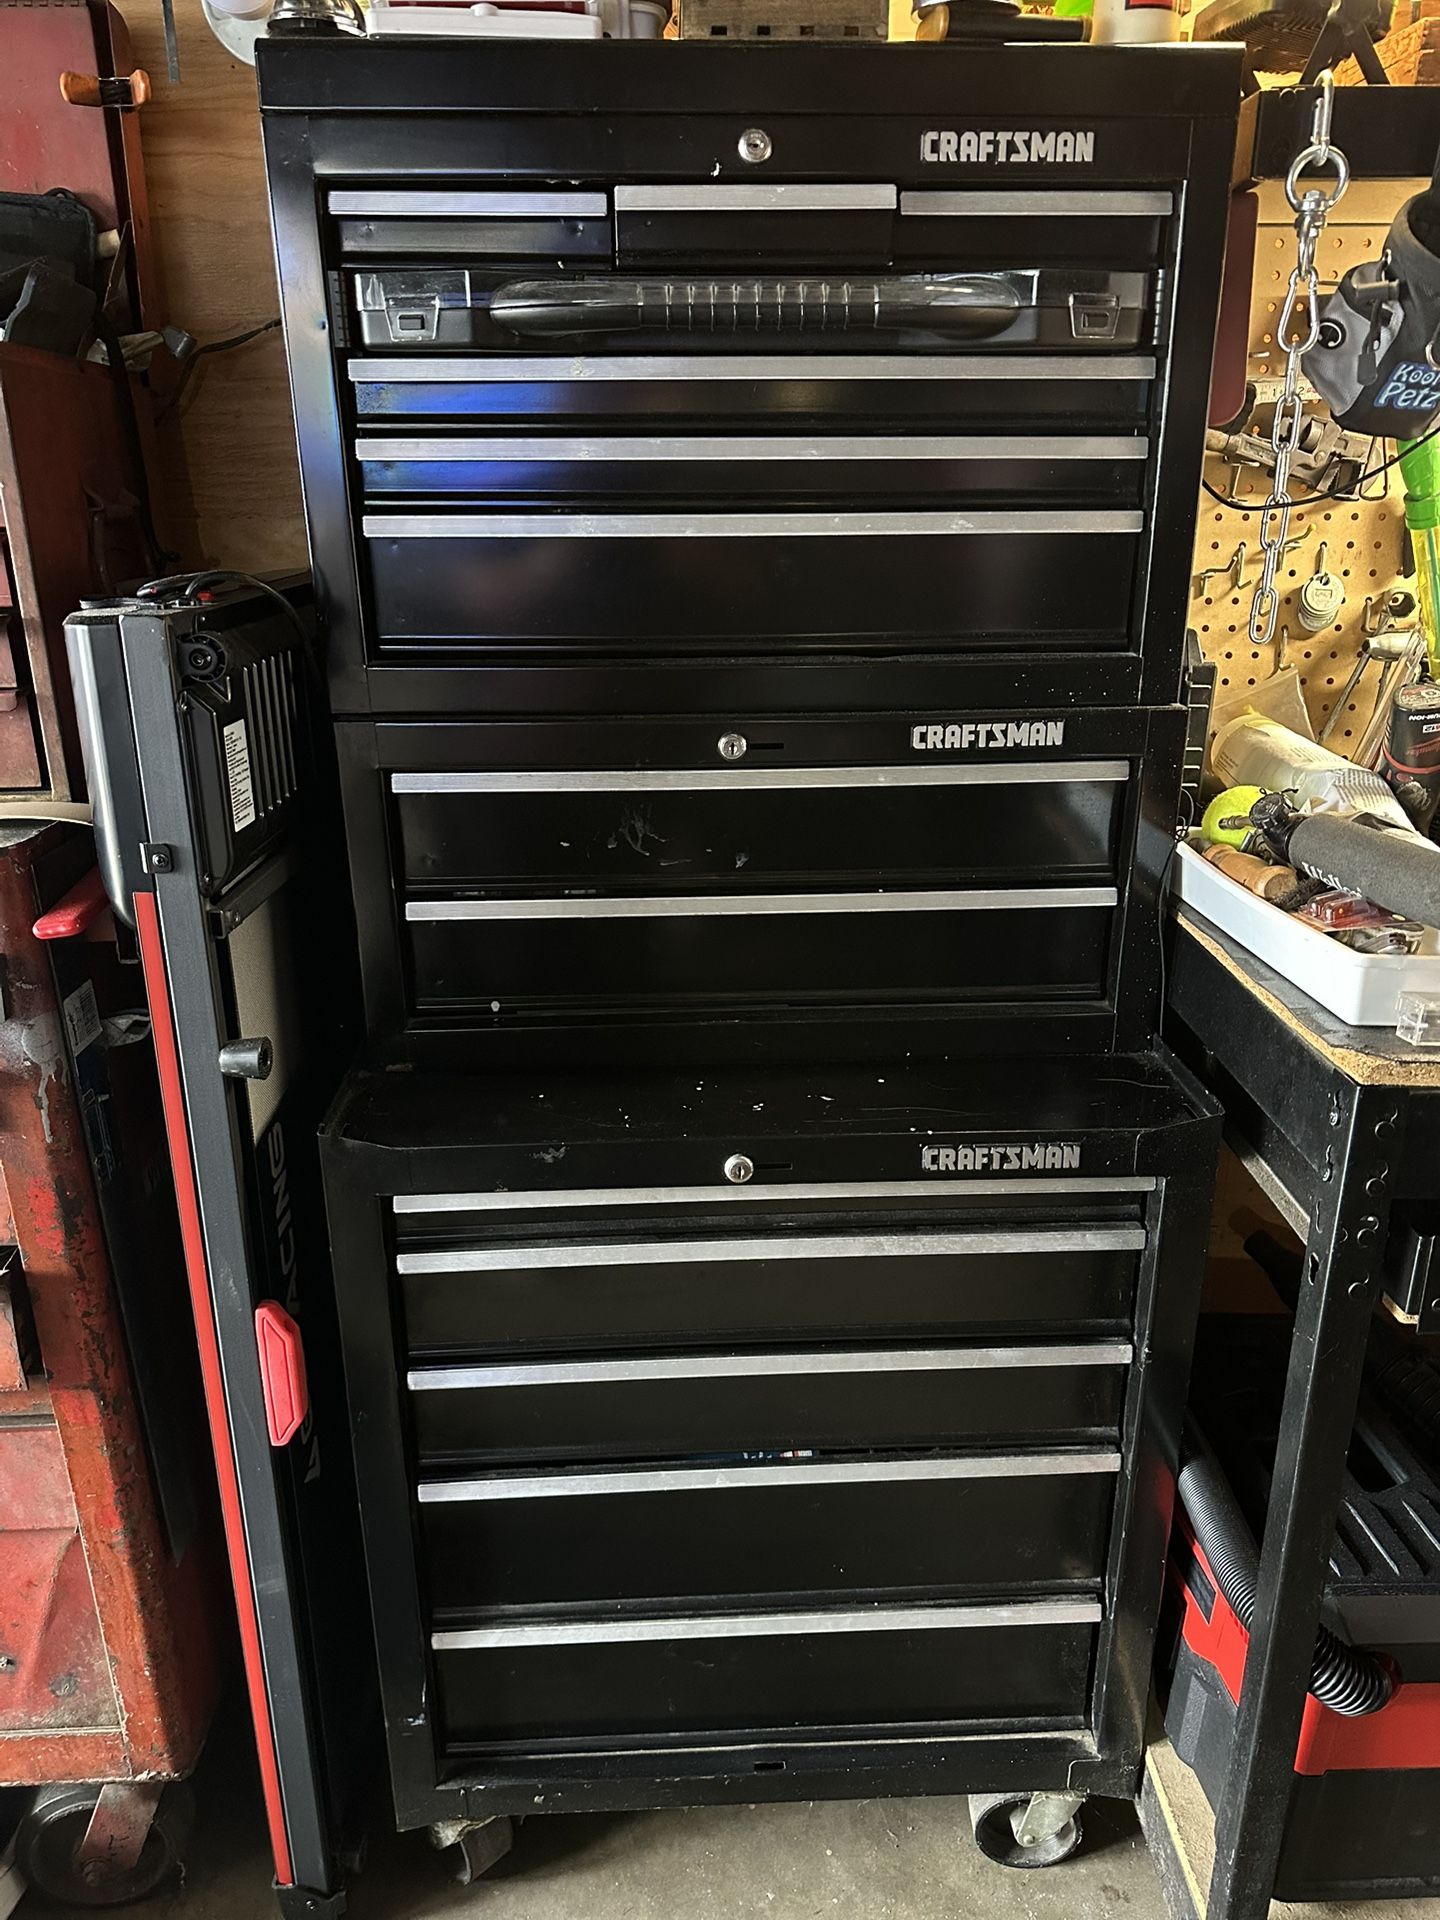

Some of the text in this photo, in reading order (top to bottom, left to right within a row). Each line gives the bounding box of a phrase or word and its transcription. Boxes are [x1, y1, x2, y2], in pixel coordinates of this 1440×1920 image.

[922, 131, 1095, 163] CRAFTSMAN
[1378, 382, 1440, 407] Petz
[911, 721, 1065, 749] CRAFTSMAN
[921, 1144, 1081, 1171] CRAFTSMAN
